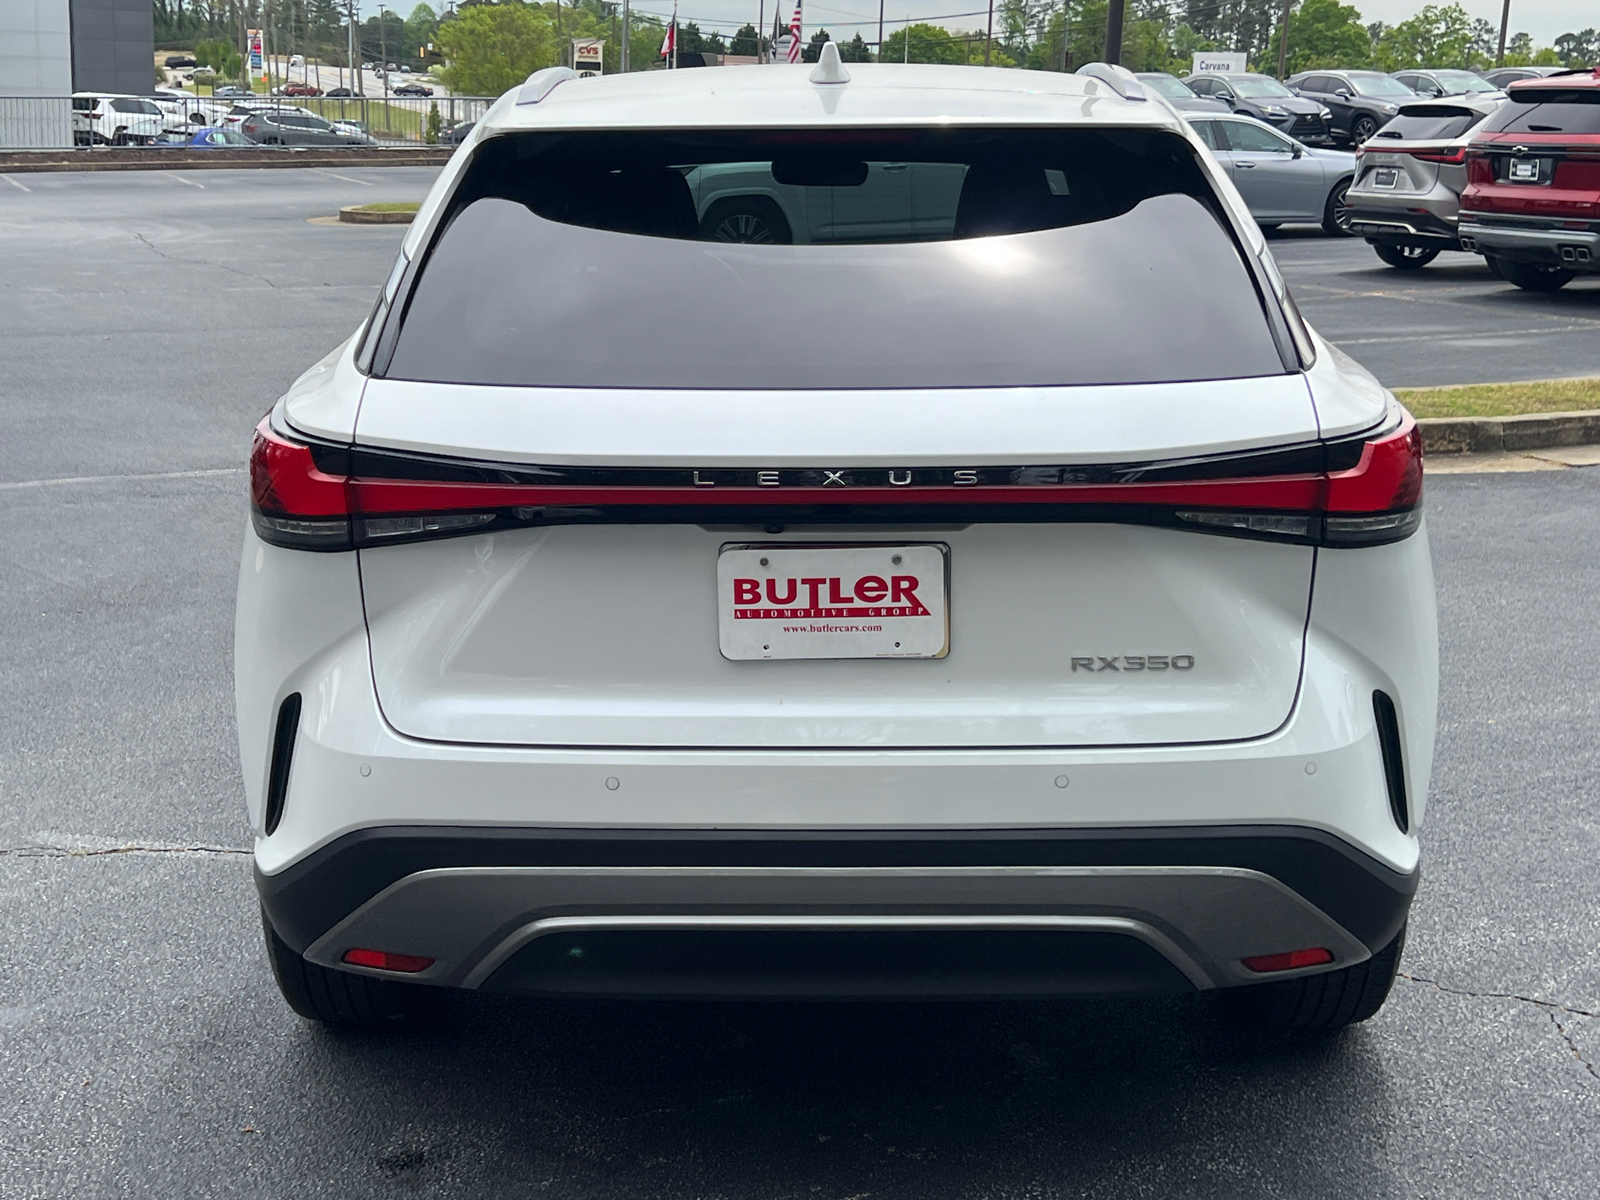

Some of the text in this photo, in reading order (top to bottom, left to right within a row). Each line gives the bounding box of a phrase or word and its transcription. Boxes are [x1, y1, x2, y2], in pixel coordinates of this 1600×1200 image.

[578, 46, 598, 55] CVS
[1199, 60, 1230, 71] Carvana
[693, 470, 978, 486] LEXUS
[735, 607, 924, 619] AUTOMOTIVE GROUP
[783, 623, 882, 633] www.butlercars.com
[1071, 654, 1195, 672] RX350
